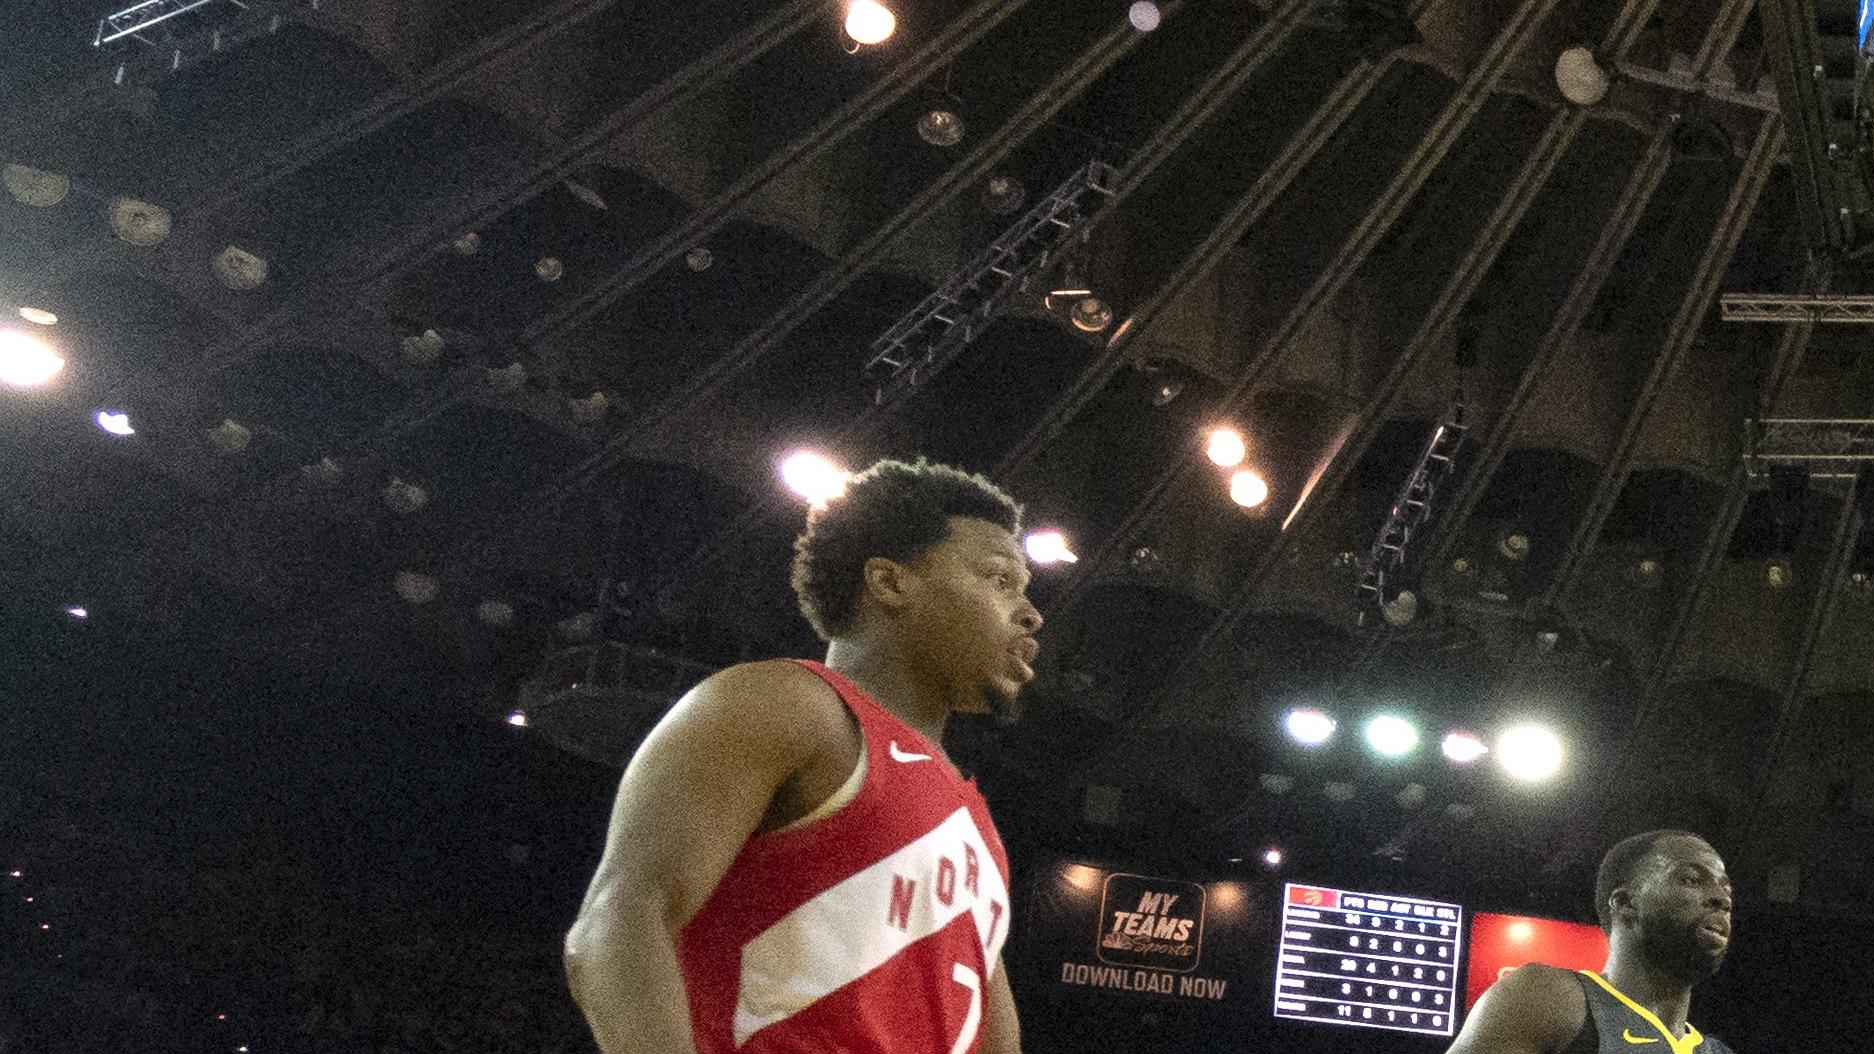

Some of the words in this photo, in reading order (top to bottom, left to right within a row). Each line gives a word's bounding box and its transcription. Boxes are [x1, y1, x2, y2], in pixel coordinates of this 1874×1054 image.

[887, 840, 1002, 951] NORT
[1136, 891, 1179, 916] MY
[1112, 911, 1194, 941] TEAMS
[1061, 962, 1174, 994] DOWNLOAD
[1179, 976, 1227, 999] NOW
